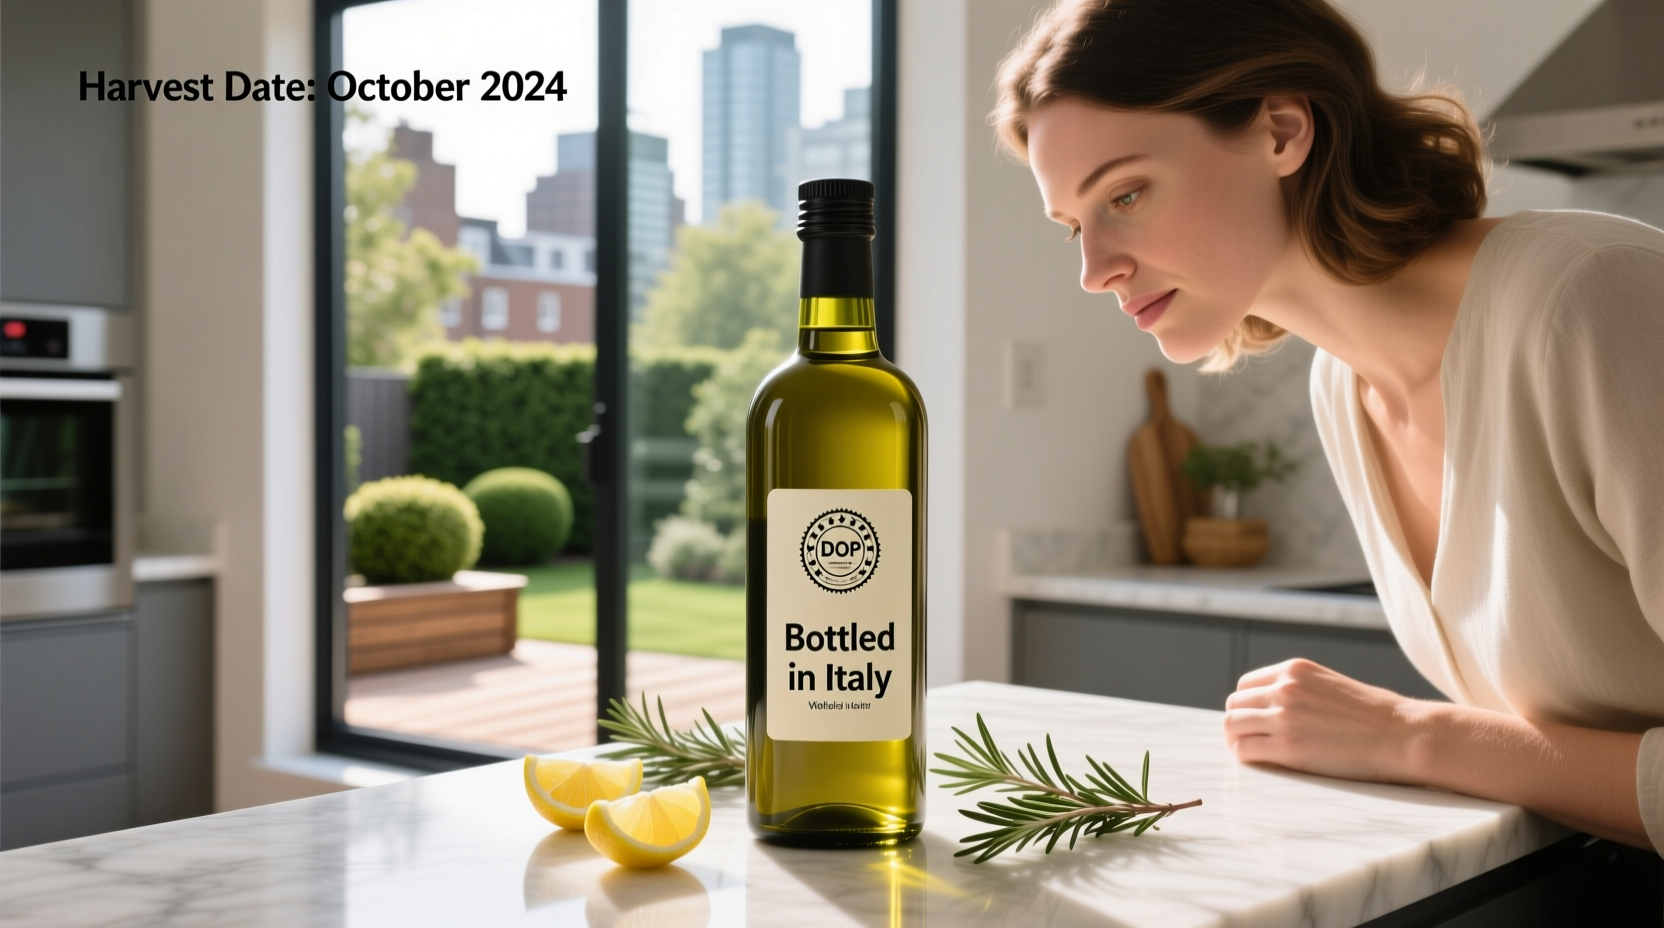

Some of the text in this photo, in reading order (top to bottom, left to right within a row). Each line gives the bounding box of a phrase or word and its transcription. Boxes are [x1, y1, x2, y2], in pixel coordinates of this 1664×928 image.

[821, 541, 861, 557] DOP
[785, 622, 895, 652] Bottled
[788, 661, 892, 699] in Italy
